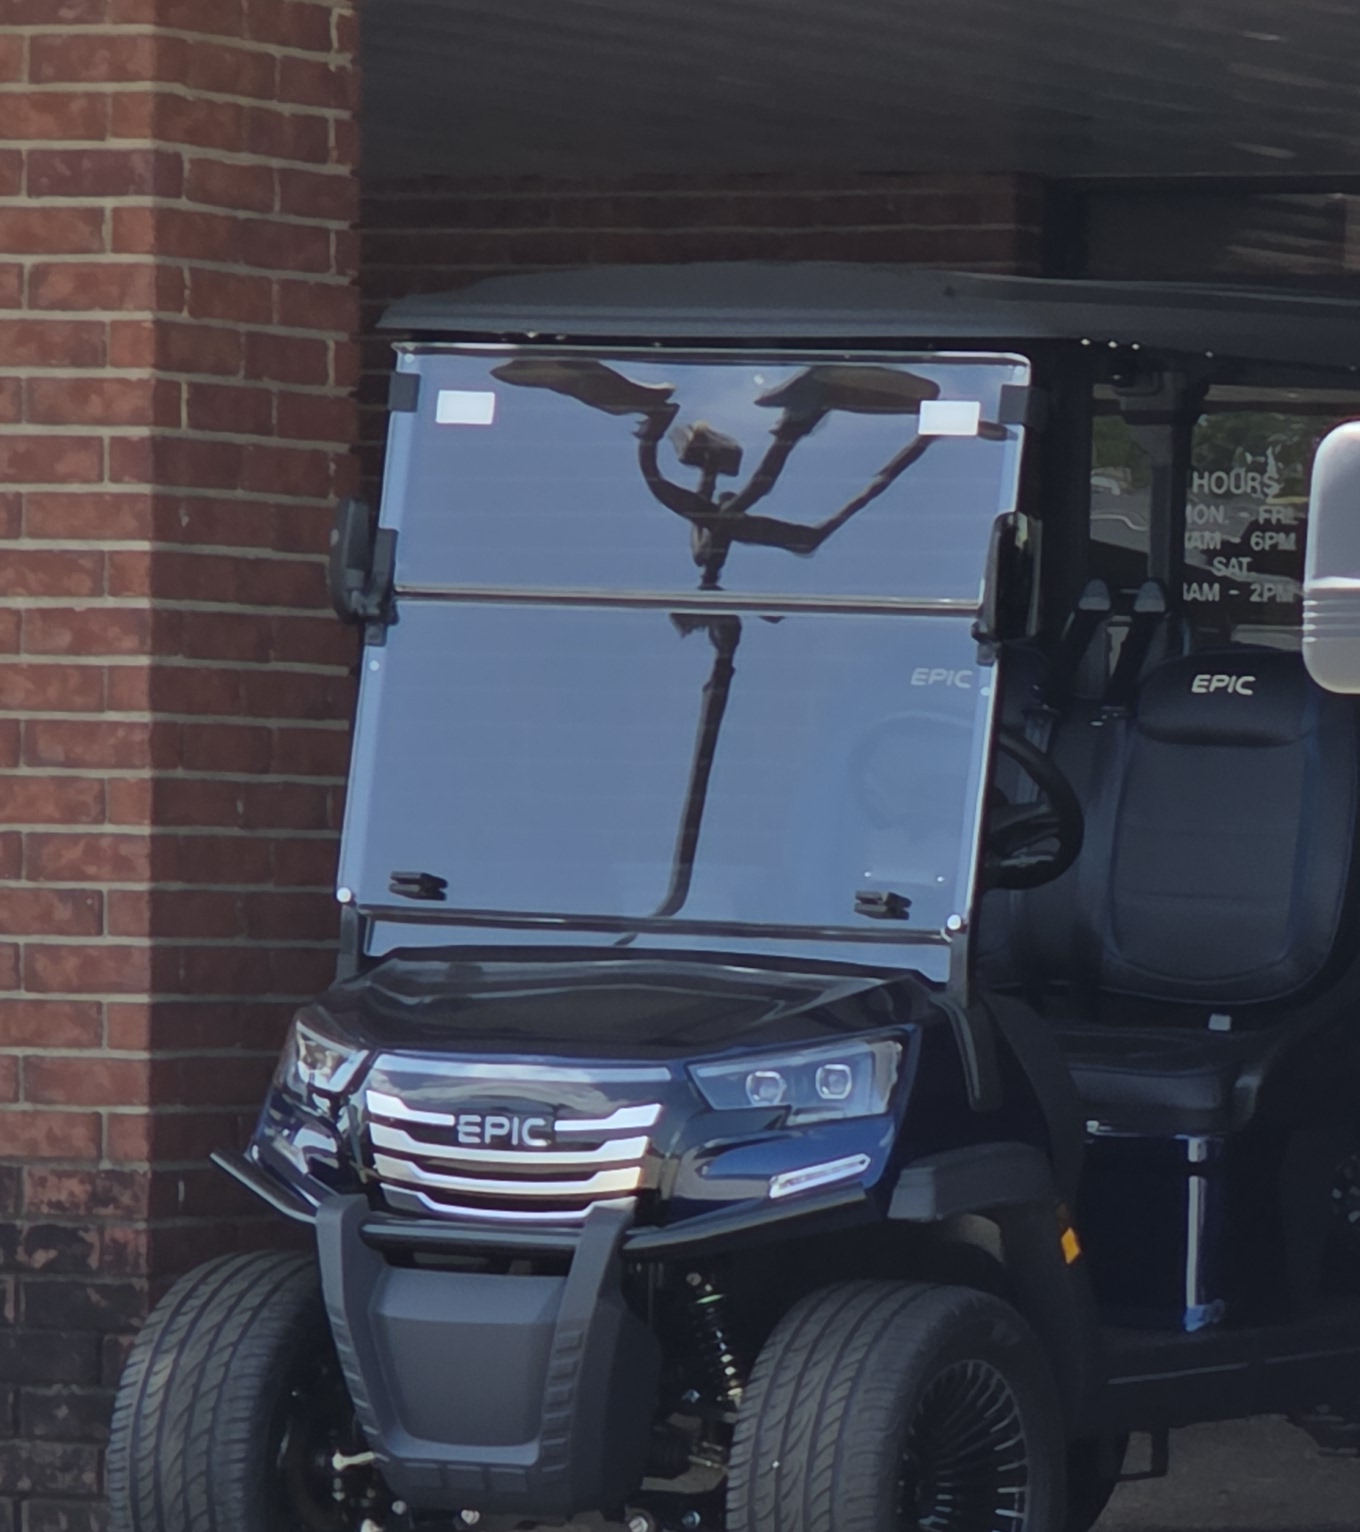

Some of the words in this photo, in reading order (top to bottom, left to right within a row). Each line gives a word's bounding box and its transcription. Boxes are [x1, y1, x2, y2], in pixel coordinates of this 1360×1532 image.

[1192, 470, 1280, 495] HOURS
[1250, 531, 1297, 551] 6PM
[911, 667, 973, 689] EPIC
[1191, 674, 1256, 696] EPIC
[458, 1114, 549, 1147] EPIC
